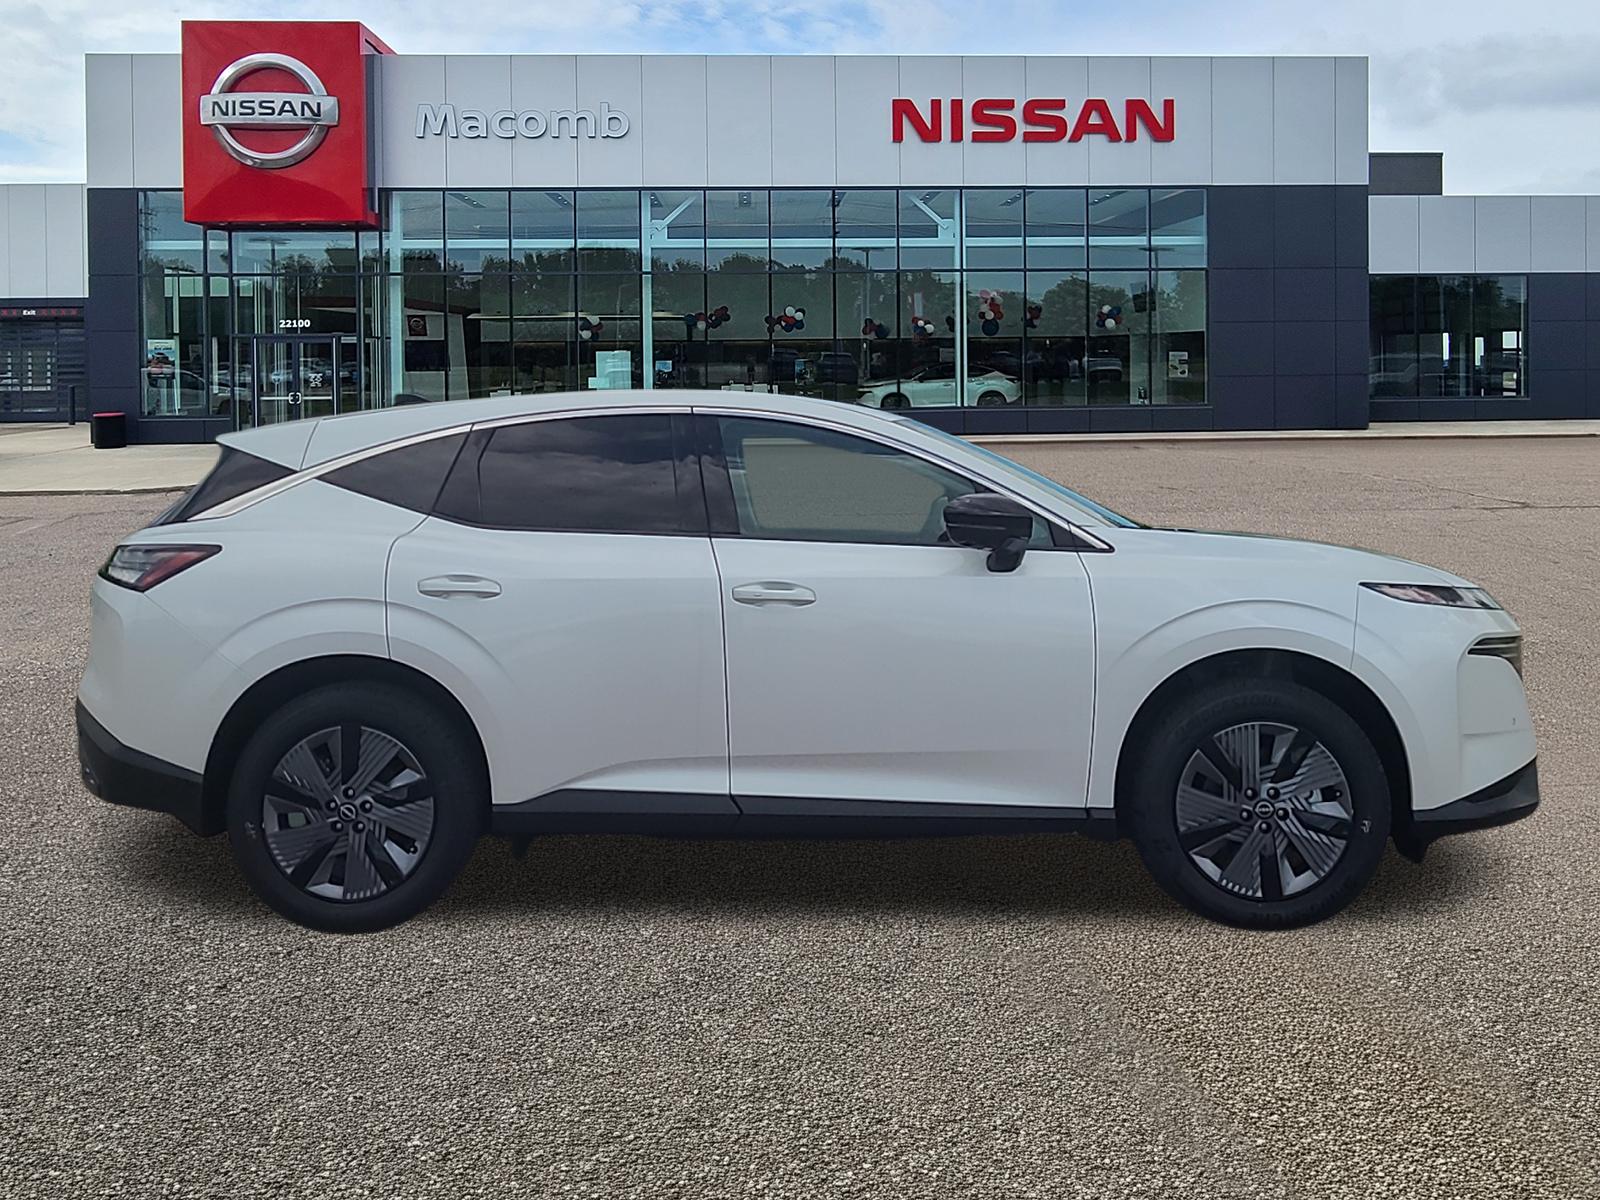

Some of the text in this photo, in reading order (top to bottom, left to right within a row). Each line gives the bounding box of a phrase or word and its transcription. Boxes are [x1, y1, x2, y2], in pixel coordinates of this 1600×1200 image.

[212, 100, 321, 118] NISSAN
[415, 101, 630, 139] Macomb
[892, 98, 1175, 143] NISSAN
[279, 319, 311, 328] 22100
